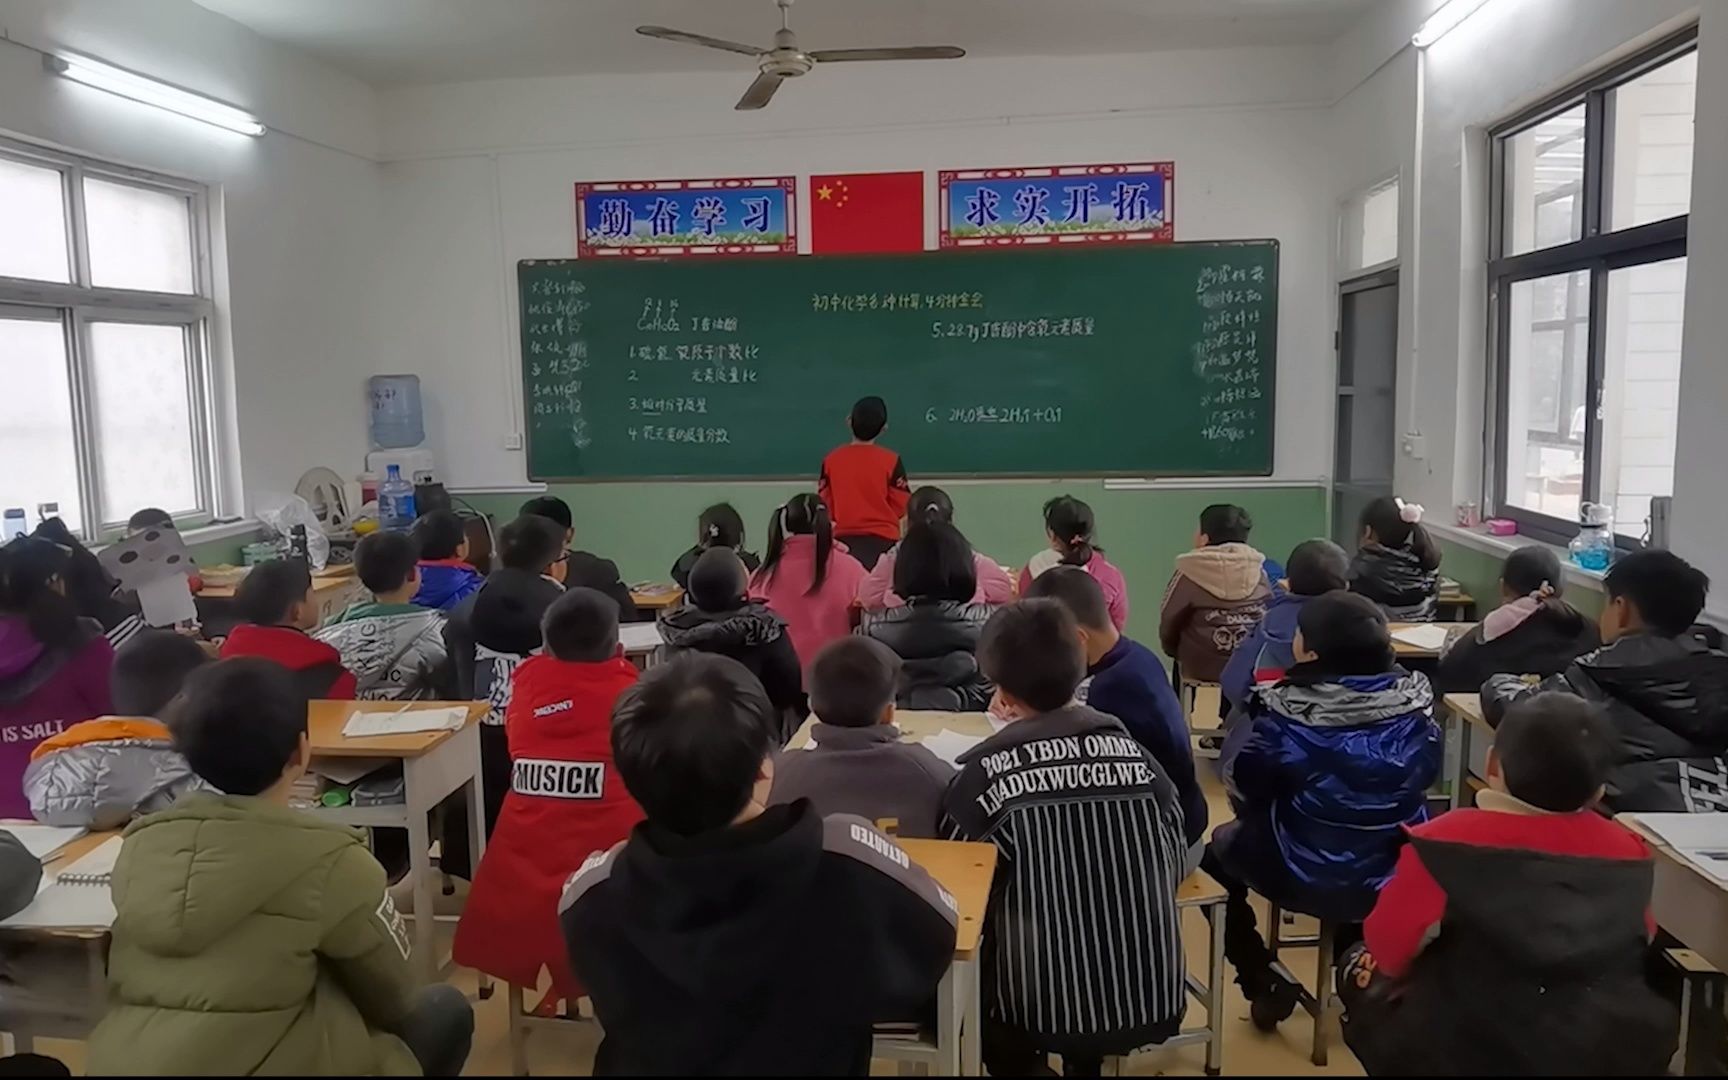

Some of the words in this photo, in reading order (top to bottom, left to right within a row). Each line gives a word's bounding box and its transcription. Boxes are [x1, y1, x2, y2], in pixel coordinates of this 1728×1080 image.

[599, 197, 771, 238] 勤奋学习
[965, 183, 1149, 228] 求实开拓
[2, 726, 19, 743] IS
[21, 719, 65, 740] SALT
[980, 746, 1023, 780] 2021
[1022, 735, 1082, 765] YBDN
[516, 762, 601, 795] MUSICK
